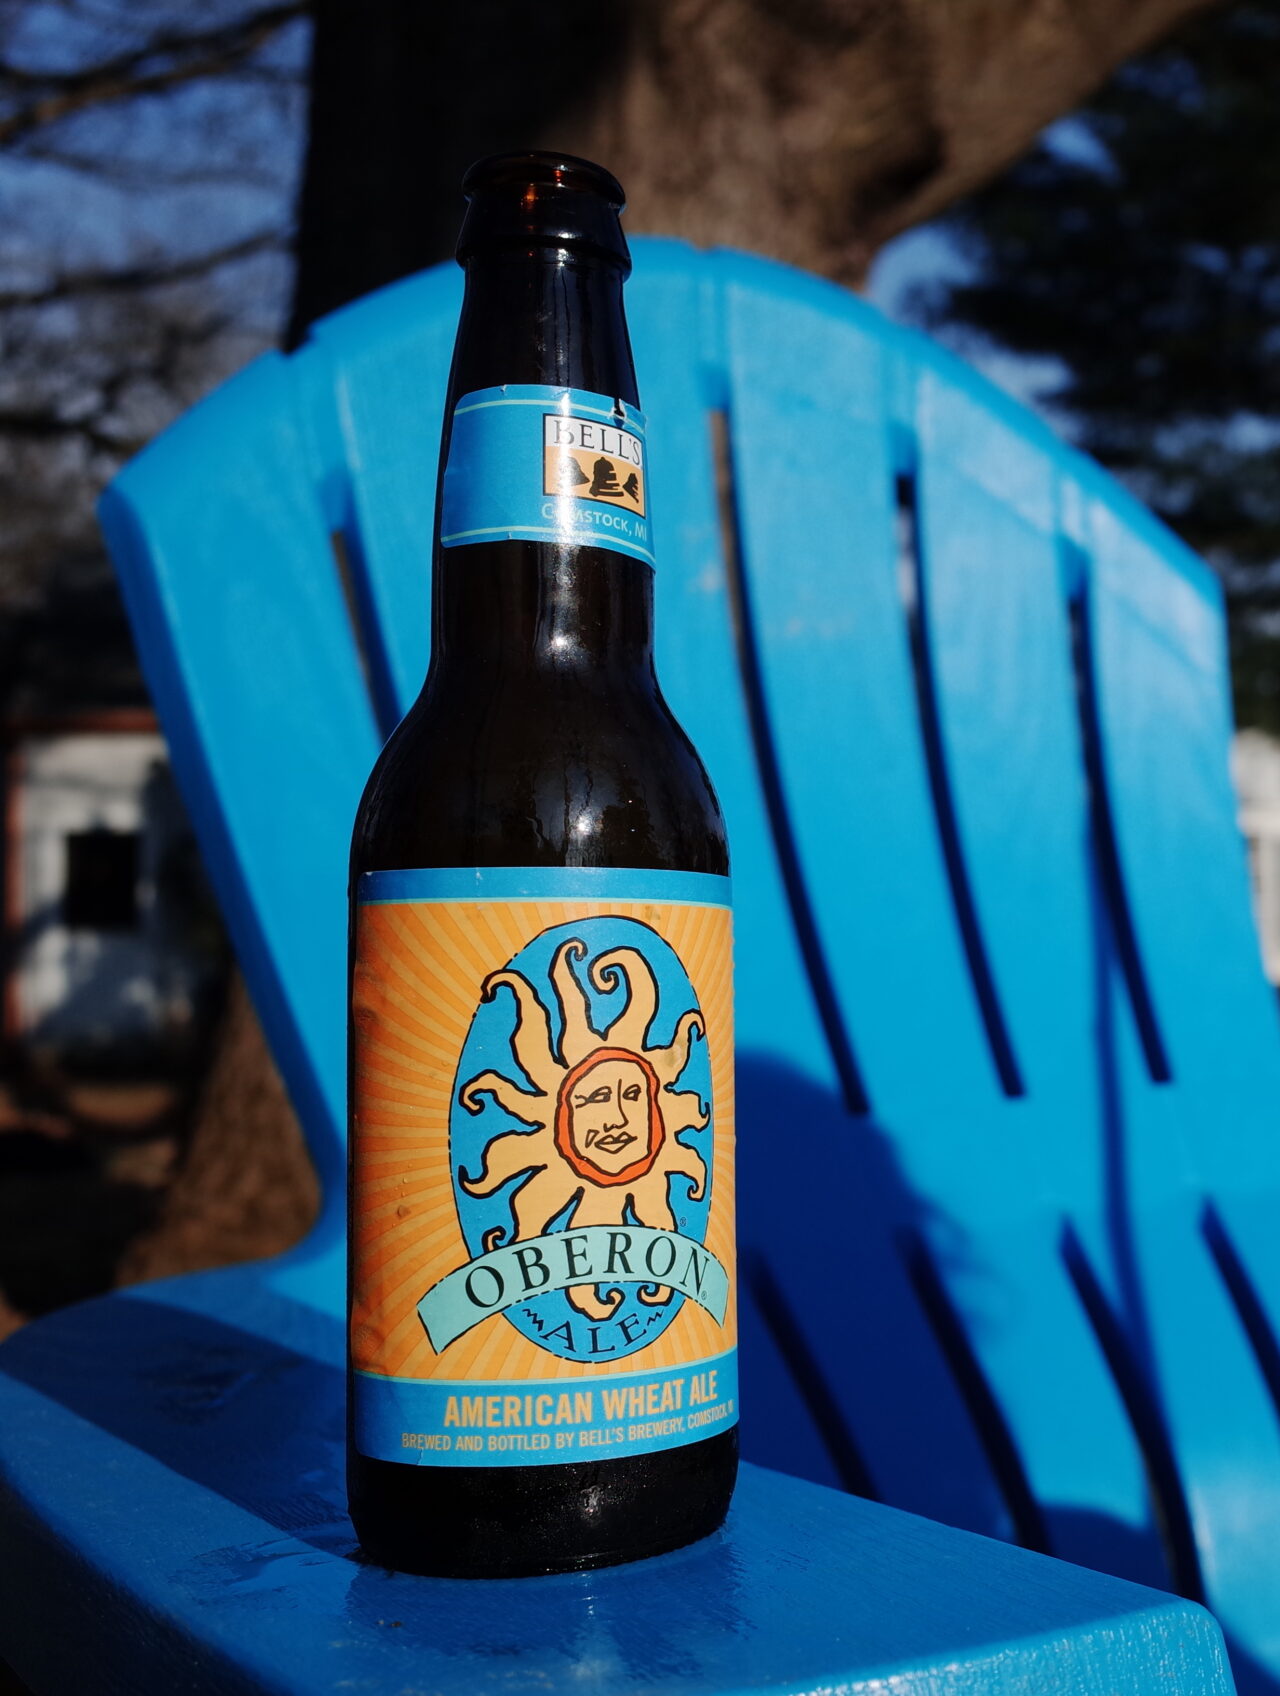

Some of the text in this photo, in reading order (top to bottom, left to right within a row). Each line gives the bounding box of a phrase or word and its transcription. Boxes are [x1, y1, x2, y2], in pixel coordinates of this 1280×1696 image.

[554, 420, 641, 466] BELL'S
[541, 503, 632, 536] CMSTOCK,
[464, 1231, 710, 1308] OBERON
[543, 1313, 647, 1354] ALE
[443, 1370, 718, 1427] AMERICAN WHEAT ALE
[401, 1432, 451, 1450] BREWED
[455, 1435, 483, 1451] AND
[488, 1433, 550, 1451] BOTTLED
[556, 1431, 574, 1448] BY
[579, 1426, 624, 1447] BELL'S
